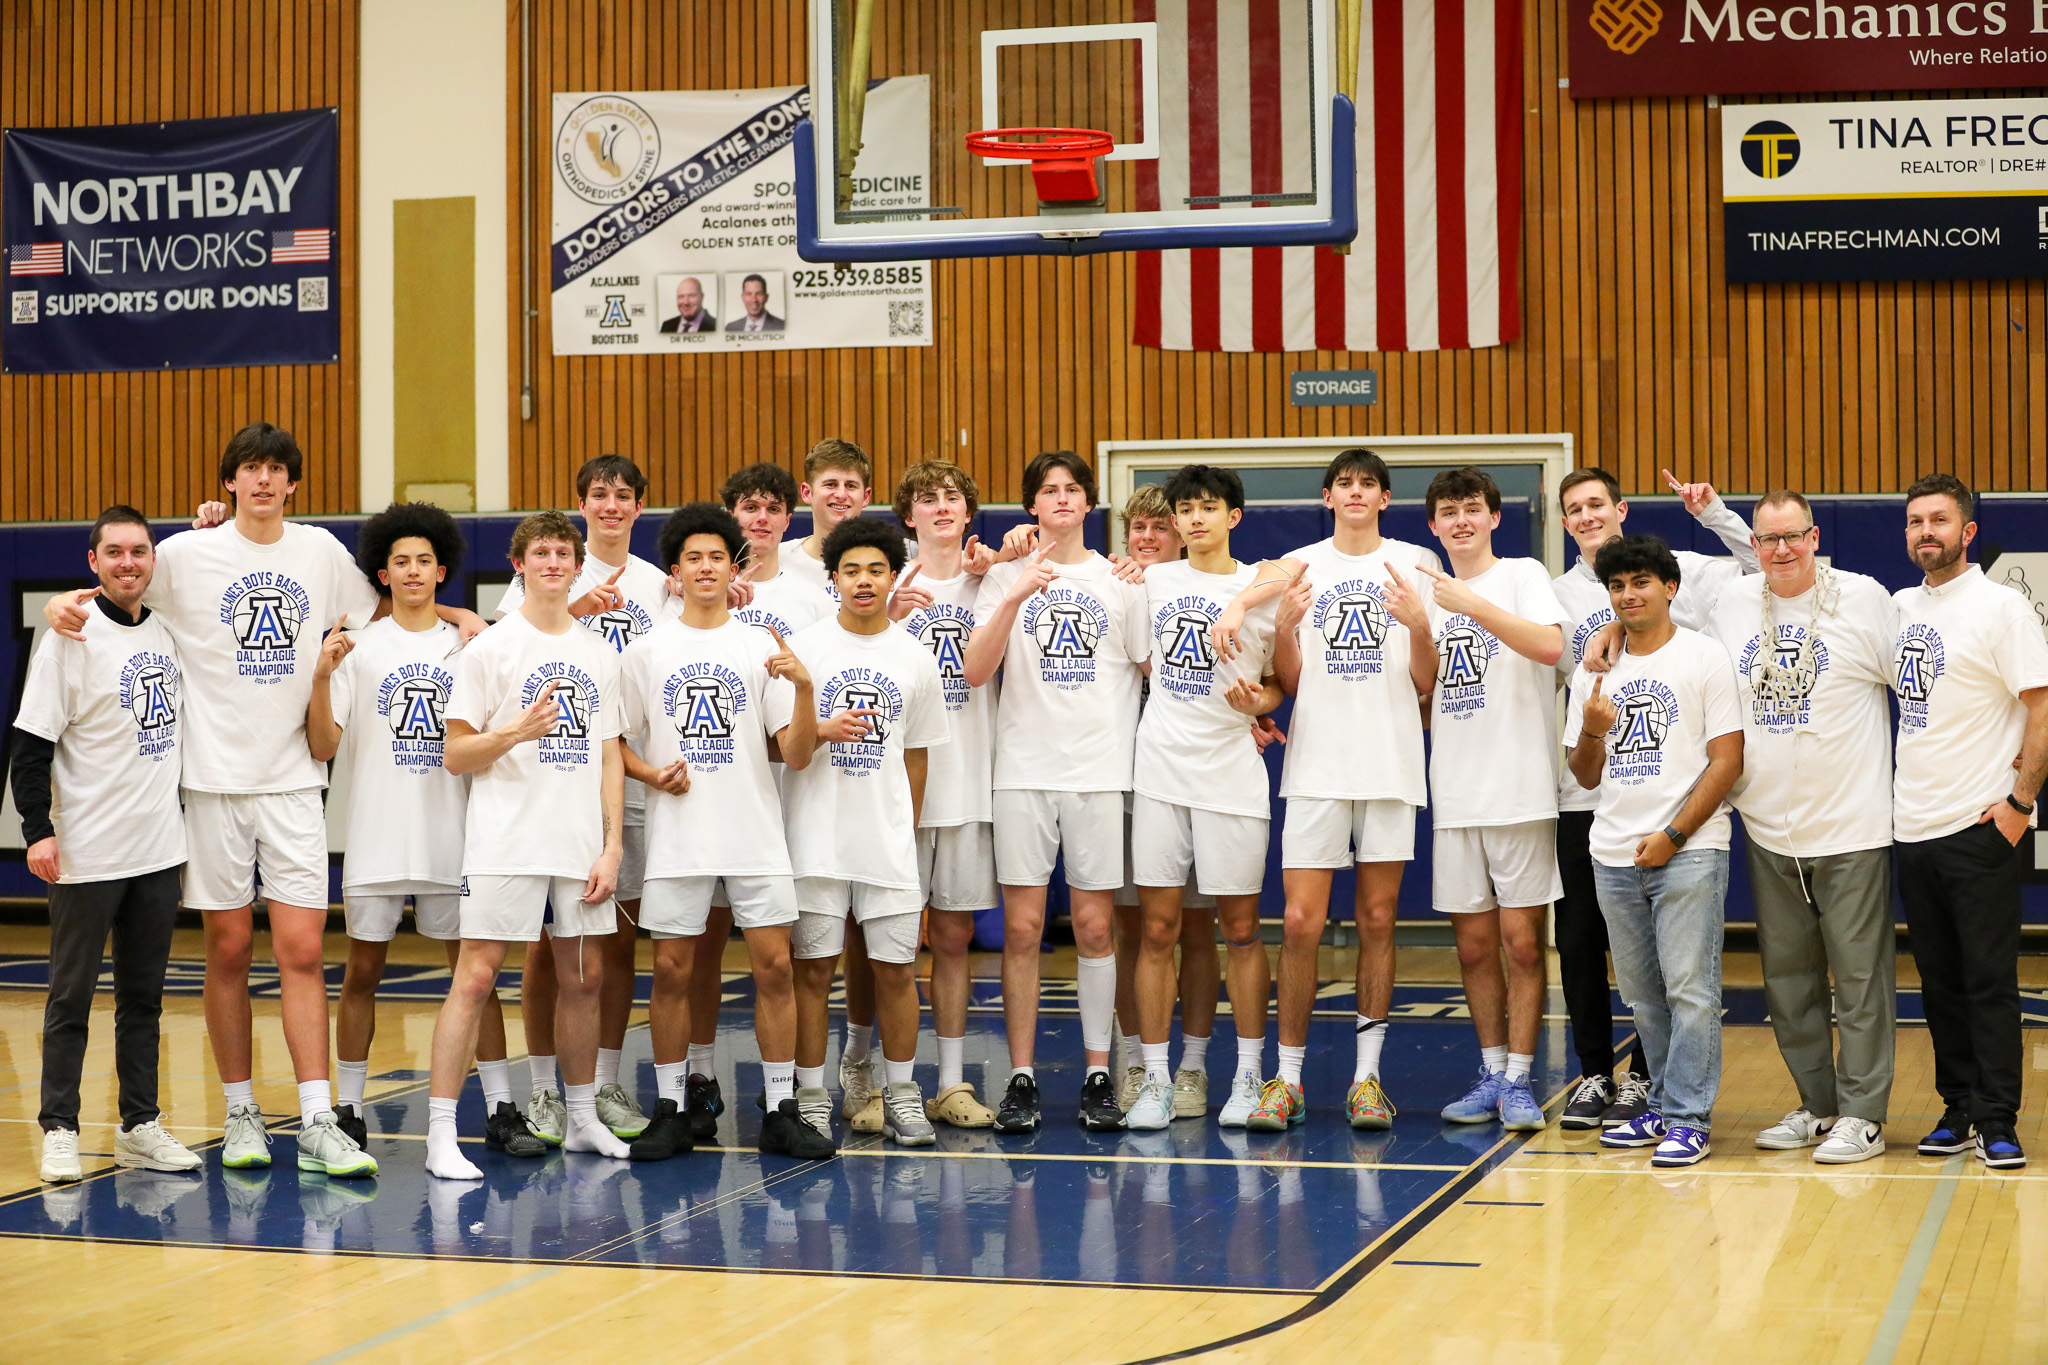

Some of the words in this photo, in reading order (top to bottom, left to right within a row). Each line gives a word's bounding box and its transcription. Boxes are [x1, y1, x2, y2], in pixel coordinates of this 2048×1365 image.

[1680, 0, 2006, 43] Mechanics
[1910, 49, 1973, 66] Where
[1980, 46, 2047, 64] Relatio
[570, 101, 613, 131] GOLDEN
[616, 102, 649, 128] STATE
[1829, 117, 1932, 150] TINA
[562, 152, 628, 200] ORTHOPEDICS
[635, 148, 656, 182] SPINE
[2000, 158, 2046, 172] DRE#
[562, 181, 671, 262] DOCTORS
[668, 162, 704, 191] TO
[703, 130, 750, 171] THE
[748, 93, 810, 140] DONS
[33, 166, 303, 226] NORTHBAY
[701, 203, 722, 213] and
[726, 200, 796, 212] award-winni
[852, 197, 876, 206] edic
[880, 198, 904, 206] care
[907, 195, 922, 204] for
[563, 237, 621, 280] PROVIDERS
[618, 227, 635, 243] OF
[635, 194, 689, 234] BOOSTERS
[688, 164, 738, 199] ATHLETIC
[702, 217, 767, 230] Acalanes
[772, 214, 796, 226] ath
[682, 238, 734, 250] GOLDEN
[736, 236, 774, 248] STATE
[778, 235, 797, 246] OR
[1748, 227, 2001, 252] TINAFRECHMAN.COM
[66, 229, 267, 276] NETWORKS
[590, 276, 640, 288] ACALANES
[792, 266, 922, 288] 925.939.8585
[45, 290, 158, 316] SUPPORTS
[164, 287, 216, 312] OUR
[220, 283, 293, 309] DONS
[794, 286, 924, 300] www.goldenstateortho.com
[600, 294, 632, 328] A
[592, 334, 639, 345] BOOSTERS
[1296, 380, 1371, 396] STORAGE
[221, 582, 244, 625] ACALANES
[242, 572, 272, 589] BOYS
[275, 574, 310, 623] BASKETBALL
[1314, 590, 1335, 629] ACALANES
[1335, 580, 1363, 595] BOYS
[241, 596, 293, 649] A
[1024, 597, 1045, 635] ACALANES
[1075, 592, 1108, 638] BASKETBALL
[1154, 602, 1176, 640] ACALANES
[1177, 596, 1205, 610] BOYS
[1330, 601, 1380, 649] A
[1445, 614, 1466, 631] BOYS
[1587, 608, 1611, 628] BOYS
[1166, 617, 1212, 671] A
[1925, 628, 1944, 678] BASKETBALL
[237, 651, 256, 662] DAL
[260, 650, 296, 662] LEAGUE
[1040, 658, 1058, 669] DAL
[1062, 659, 1096, 669] LEAGUE
[1326, 651, 1343, 661] DAL
[1347, 650, 1383, 661] LEAGUE
[239, 663, 294, 676] CHAMPIONS
[1043, 671, 1095, 682] CHAMPIONS
[1160, 664, 1175, 678] DAL
[1178, 669, 1214, 683] LEAGUE
[1328, 663, 1382, 674] CHAMPIONS
[120, 666, 135, 709] ACALANES
[128, 652, 151, 670] BOYS
[378, 673, 400, 716] ACALANES
[398, 663, 428, 679] BOYS
[538, 662, 564, 678] BOYS
[568, 665, 600, 715] BASKETBALL
[663, 674, 682, 717] ACALANES
[680, 663, 710, 679] BOYS
[713, 664, 746, 714] BASKETBALL
[1161, 677, 1211, 696] CHAMPIONS
[140, 672, 176, 730] A
[820, 676, 843, 719] ACALANES
[841, 668, 870, 683] BOYS
[873, 672, 903, 723] BASKETBALL
[1442, 689, 1453, 700] AL
[1455, 685, 1485, 699] LEAGUE
[1621, 679, 1647, 697] BOYS
[1649, 680, 1679, 726] BASKETBALL
[396, 687, 444, 741] A
[682, 686, 730, 738] A
[1441, 698, 1485, 713] CHAMPIONS
[138, 731, 155, 743] DAL
[392, 741, 410, 752] DAL
[412, 741, 444, 753] LEAGUE
[539, 739, 554, 749] DAL
[558, 739, 590, 750] LEAGUE
[697, 739, 734, 750] LEAGUE
[540, 752, 588, 764] CHAMPIONS
[830, 742, 847, 753] DAL
[851, 744, 885, 757] LEAGUE
[1610, 755, 1624, 766] DAL
[1627, 752, 1663, 764] LEAGUE
[395, 754, 443, 767] CHAMPIONS
[832, 755, 882, 769] CHAMPIONS
[1610, 765, 1660, 778] CHAMPIONS
